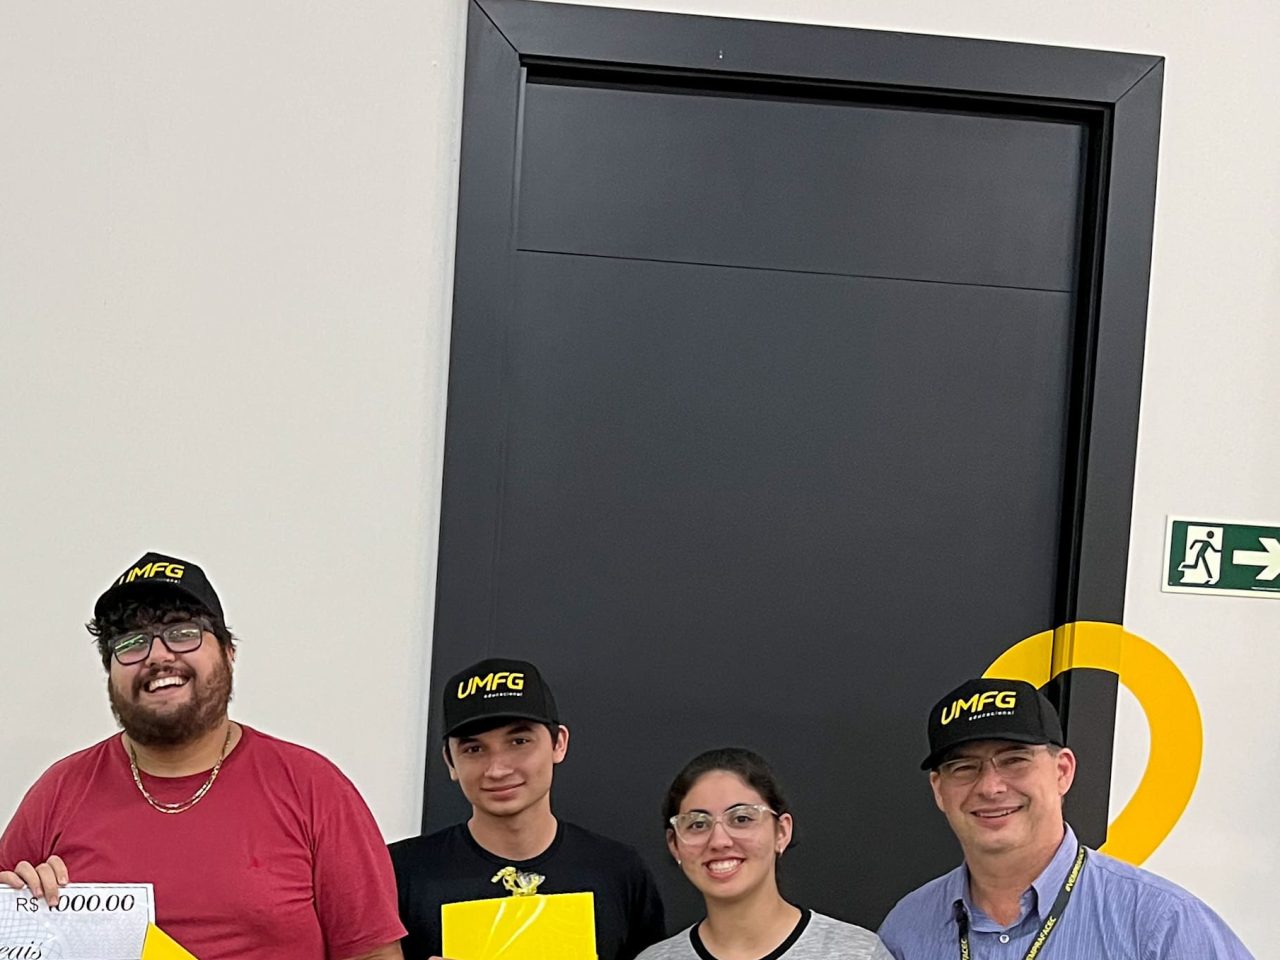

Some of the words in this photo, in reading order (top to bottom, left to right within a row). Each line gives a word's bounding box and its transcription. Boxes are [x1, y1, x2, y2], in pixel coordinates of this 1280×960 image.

[457, 672, 524, 699] UMFG
[940, 691, 1016, 725] UMFG
[48, 894, 135, 912] 000.00
